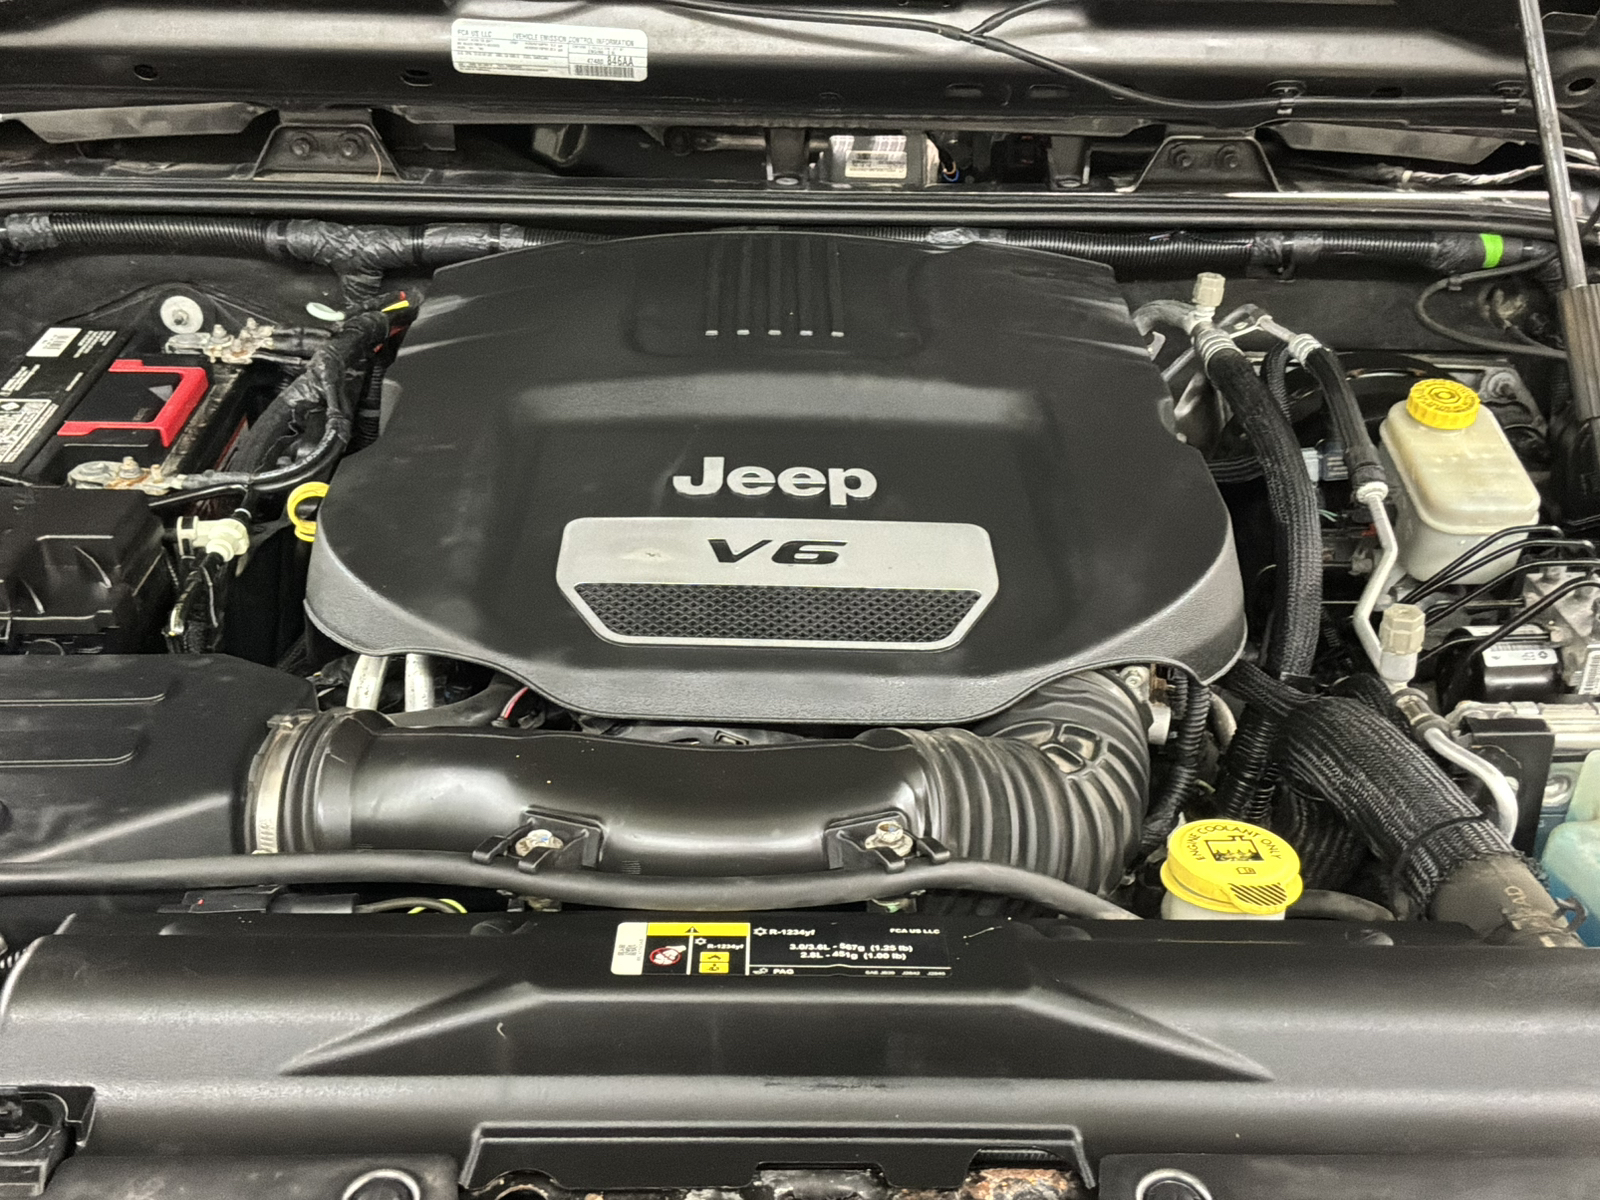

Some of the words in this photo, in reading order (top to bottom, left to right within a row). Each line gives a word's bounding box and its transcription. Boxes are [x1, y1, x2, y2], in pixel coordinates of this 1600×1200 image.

[515, 33, 538, 41] VEHICLE
[540, 34, 567, 42] EMISSION
[568, 36, 594, 44] CONTROL
[596, 38, 635, 47] INFORMATION
[672, 456, 878, 508] Jeep
[707, 538, 848, 565] V6
[1186, 832, 1206, 861] ENGINE
[1197, 824, 1261, 838] COOLANT
[1260, 838, 1282, 860] ONLY
[769, 928, 816, 937] R-1234yf
